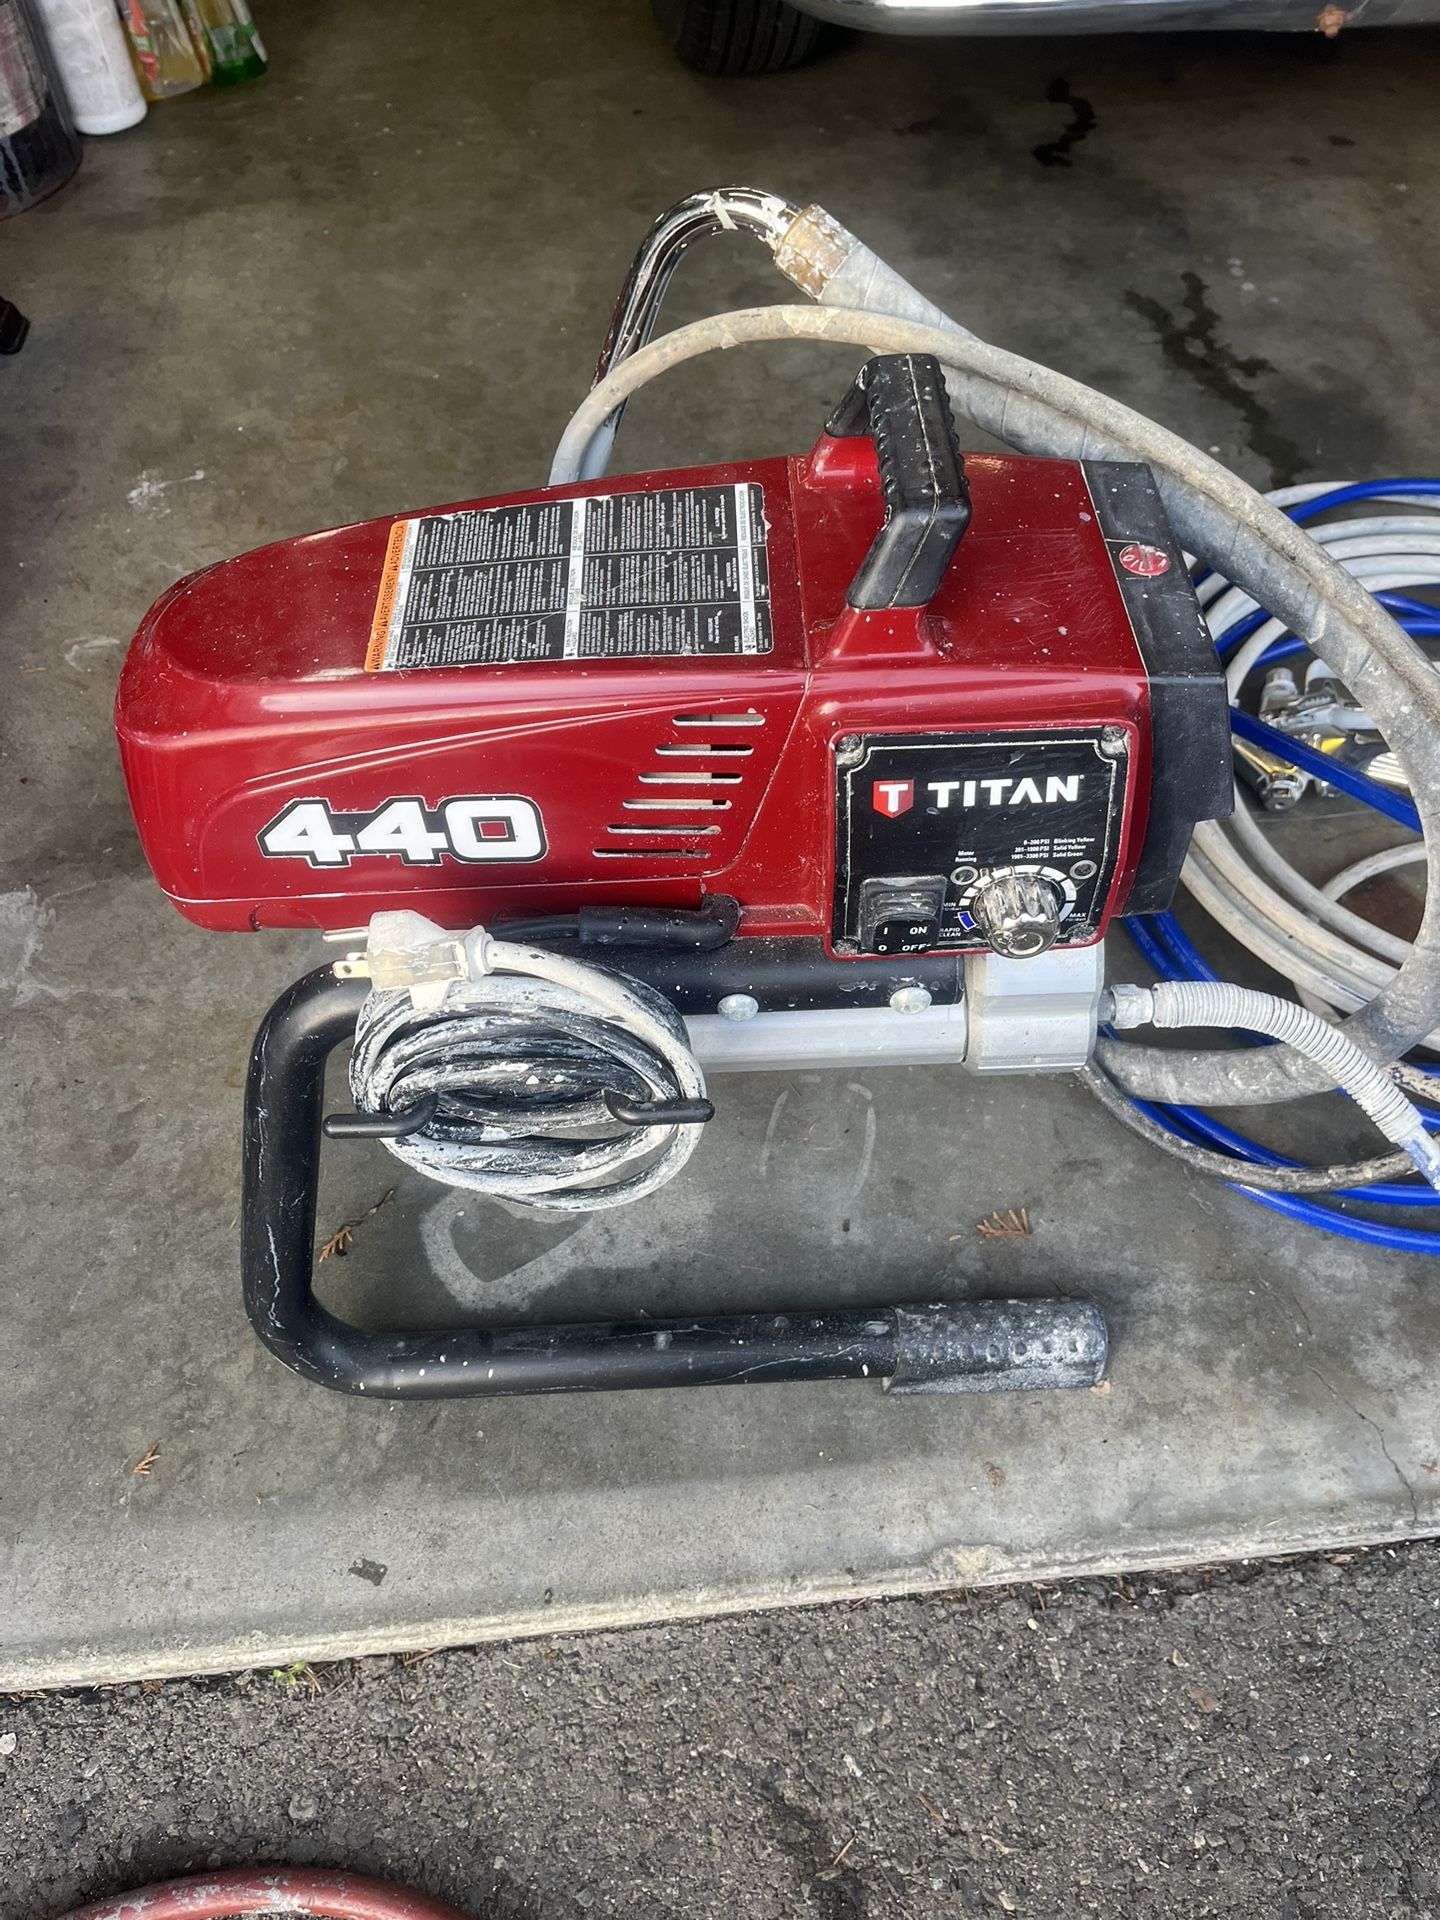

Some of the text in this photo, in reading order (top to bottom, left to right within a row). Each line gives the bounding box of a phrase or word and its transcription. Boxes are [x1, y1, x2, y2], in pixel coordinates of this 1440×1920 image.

[389, 524, 405, 564] ADVERTENCIA
[380, 575, 397, 620] AVERTISSEMENT
[371, 630, 386, 662] WARNING
[927, 775, 1080, 809] TITAN
[261, 798, 544, 865] 440
[902, 943, 927, 952] OFF
[909, 926, 928, 935] ON
